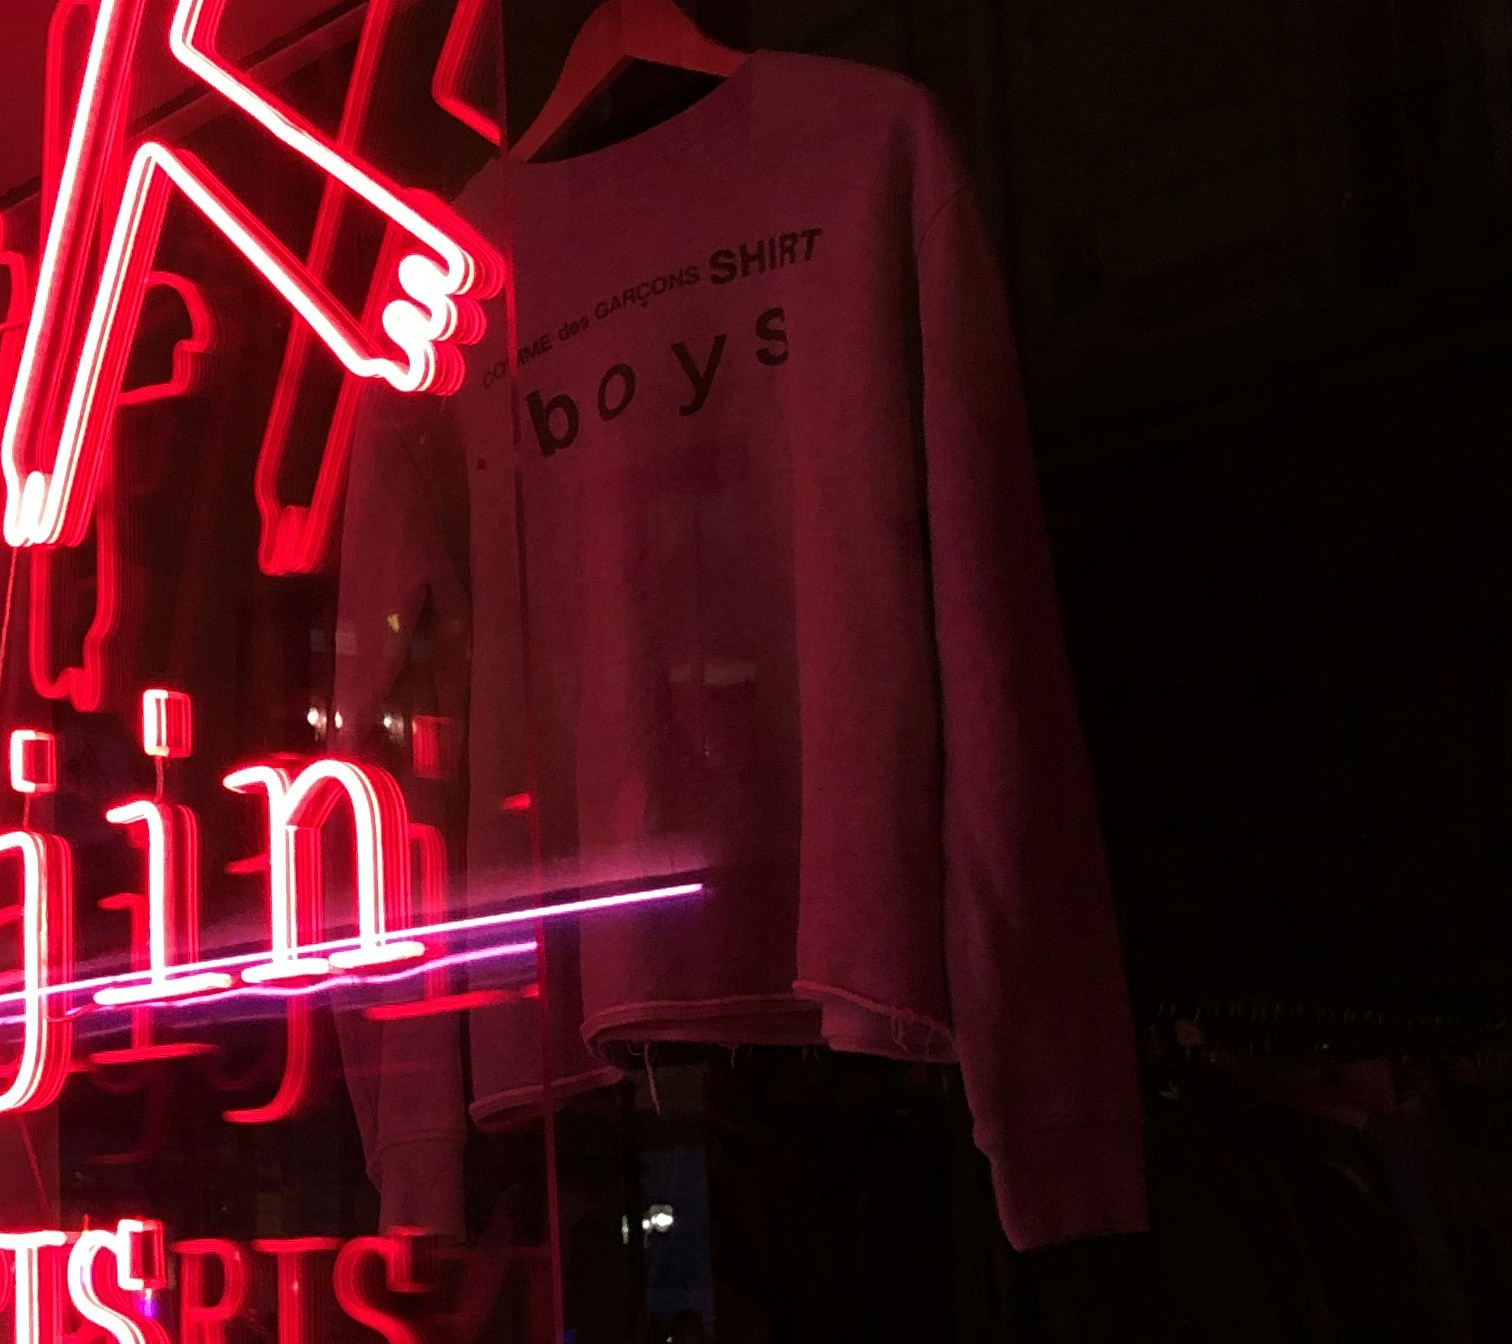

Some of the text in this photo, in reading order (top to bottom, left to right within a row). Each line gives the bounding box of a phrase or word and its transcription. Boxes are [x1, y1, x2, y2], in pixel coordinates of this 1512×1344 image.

[593, 264, 701, 320] GARÇONS
[707, 228, 823, 286] SHIRT
[526, 306, 791, 455] boys
